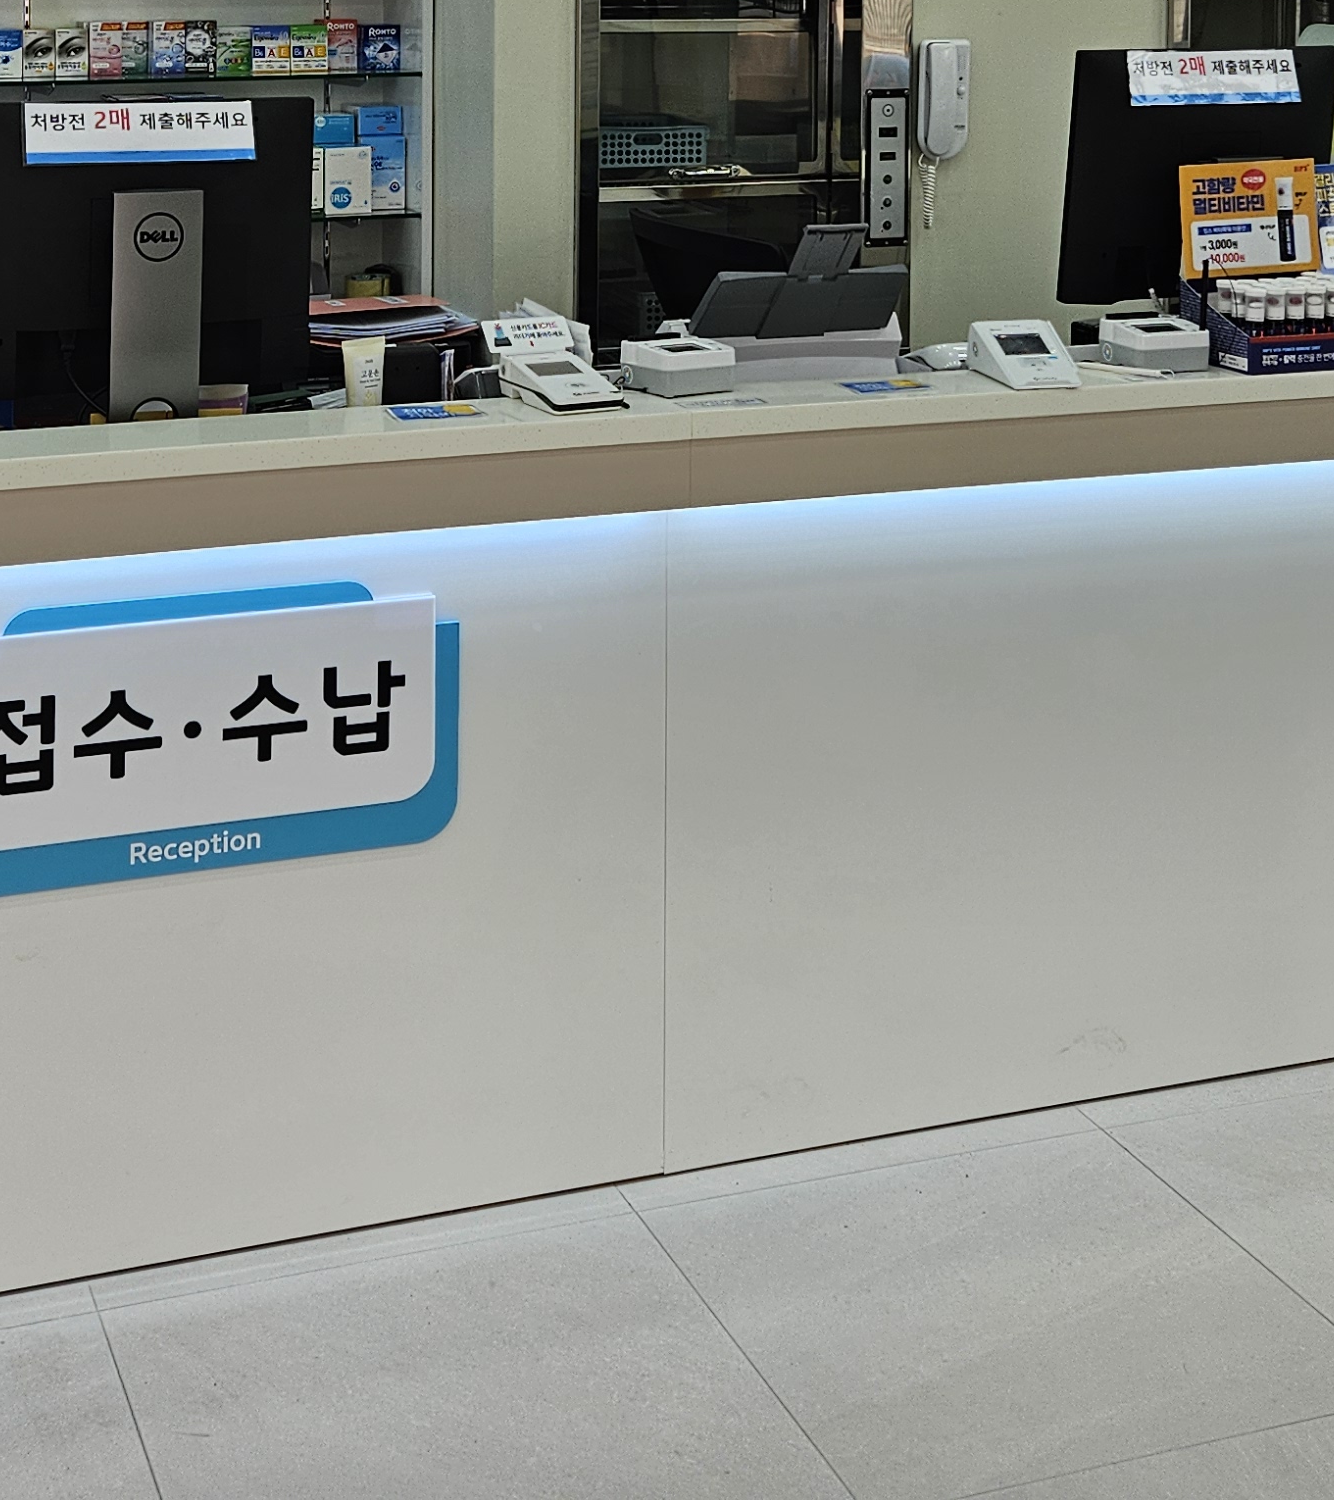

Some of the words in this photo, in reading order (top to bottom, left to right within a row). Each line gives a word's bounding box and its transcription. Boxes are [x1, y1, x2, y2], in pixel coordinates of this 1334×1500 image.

[1133, 58, 1173, 77] 처방전
[1179, 54, 1206, 76] 2매
[1212, 57, 1292, 75] 제출해주세요
[30, 113, 85, 132] 처방전
[94, 108, 130, 132] 2매
[140, 112, 248, 131] 제출해주세요
[1192, 177, 1236, 195] 고함량
[1193, 194, 1265, 215] 멀티비타민
[139, 230, 179, 244] DELL
[129, 829, 261, 866] Reception
